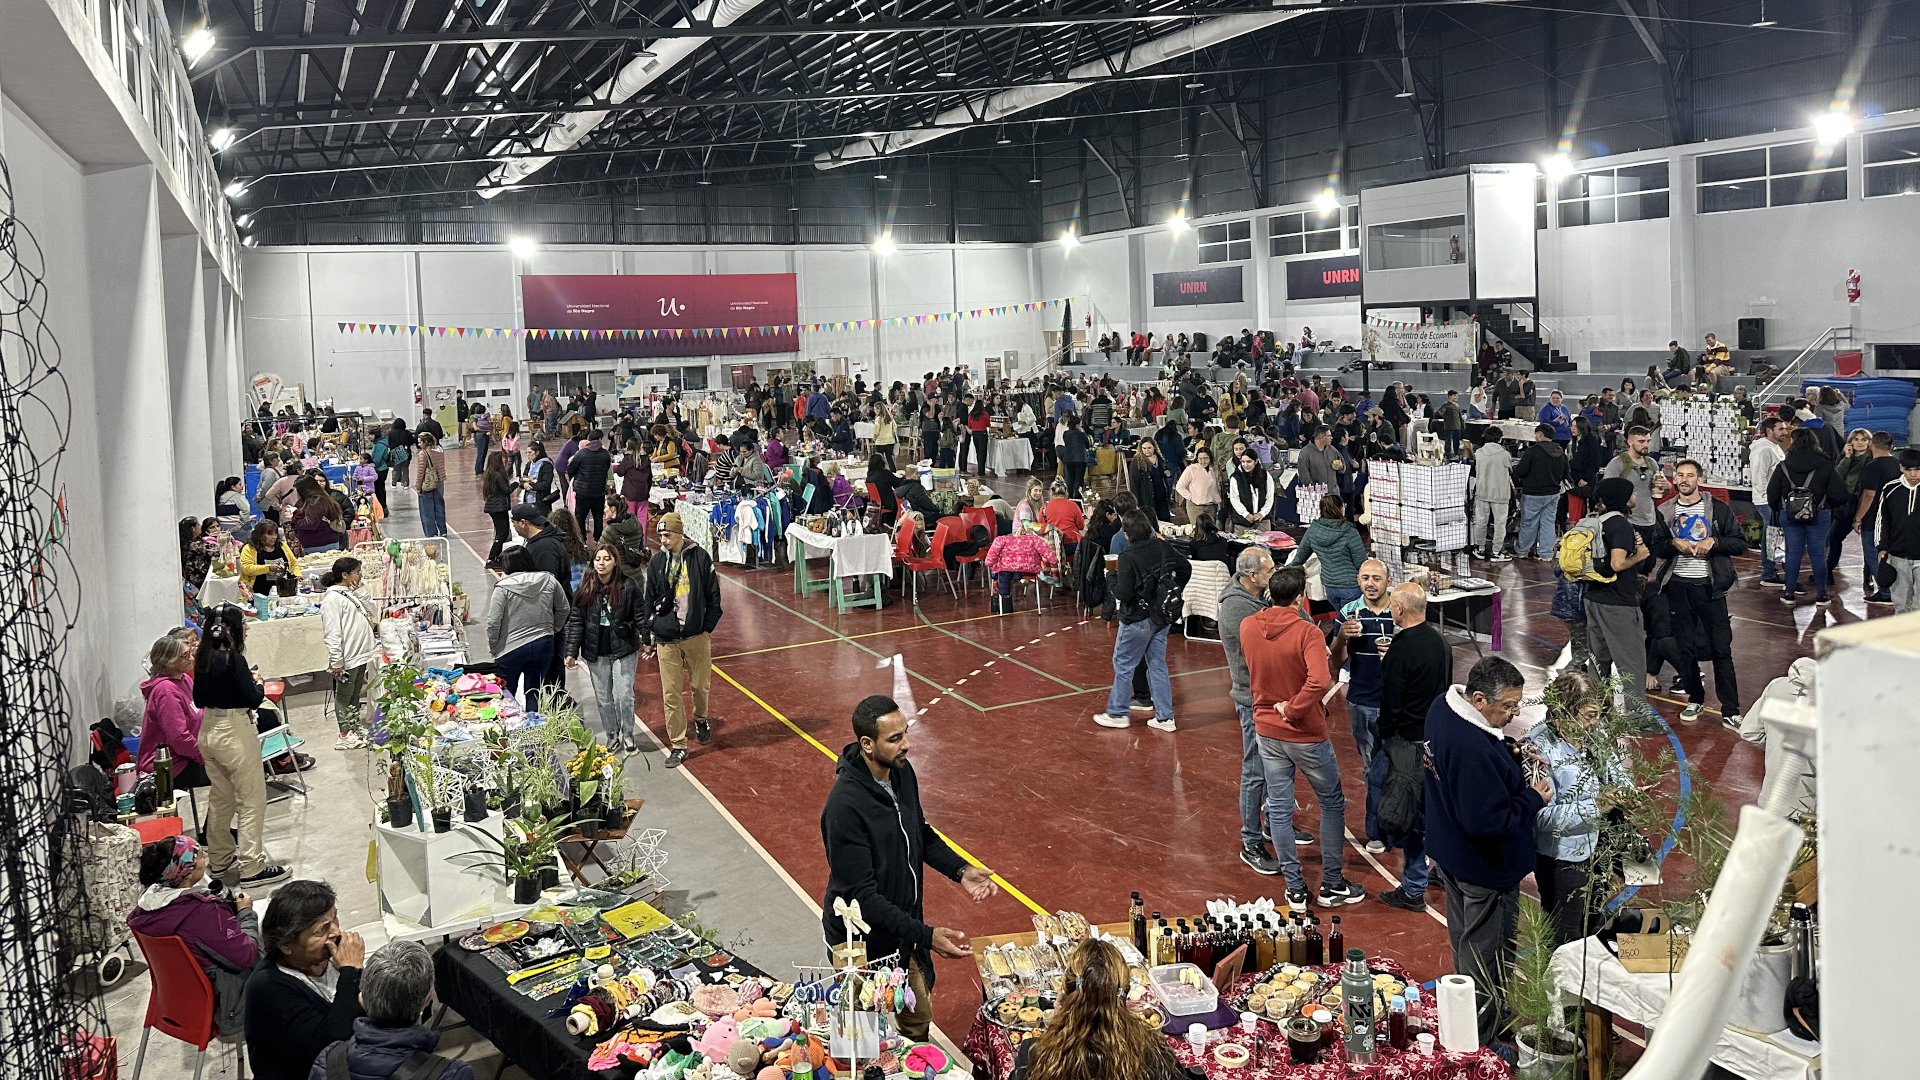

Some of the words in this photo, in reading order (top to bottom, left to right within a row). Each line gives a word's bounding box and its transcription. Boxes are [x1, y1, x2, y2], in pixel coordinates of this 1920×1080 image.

[1322, 268, 1359, 285] UNRN
[1180, 281, 1207, 294] UNRN
[1388, 331, 1419, 339] Encuentro
[1420, 331, 1428, 339] de
[1395, 341, 1415, 349] Social
[1416, 342, 1421, 350] y
[1421, 341, 1449, 349] Solidaria
[1620, 948, 1640, 957] 2500
